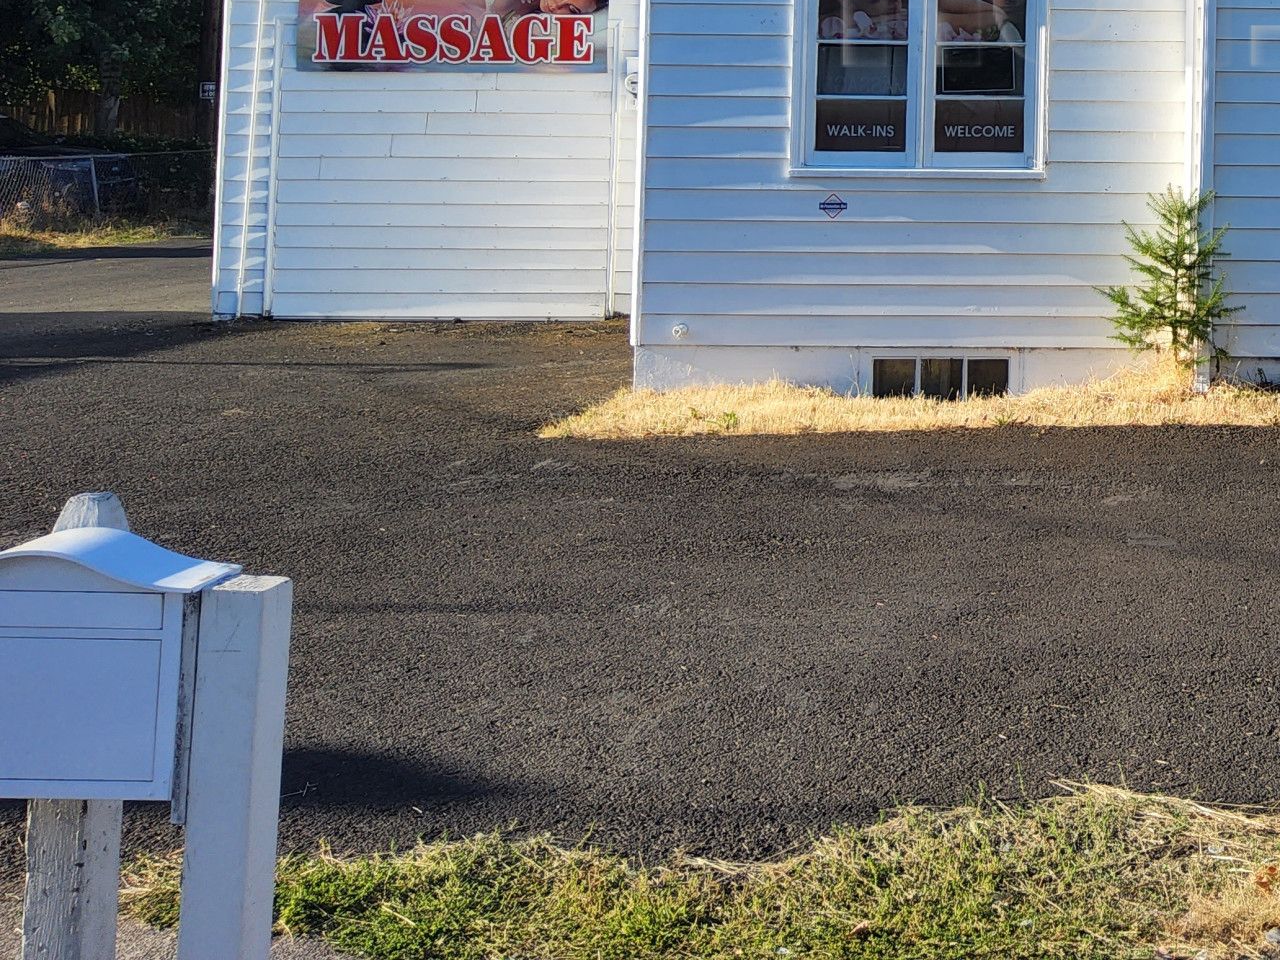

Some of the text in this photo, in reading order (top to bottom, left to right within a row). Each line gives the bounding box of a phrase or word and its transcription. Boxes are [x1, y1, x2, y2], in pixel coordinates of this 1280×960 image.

[313, 13, 594, 63] MASSAGE
[827, 124, 895, 138] WALK-INS
[944, 125, 1015, 138] WELCOME
